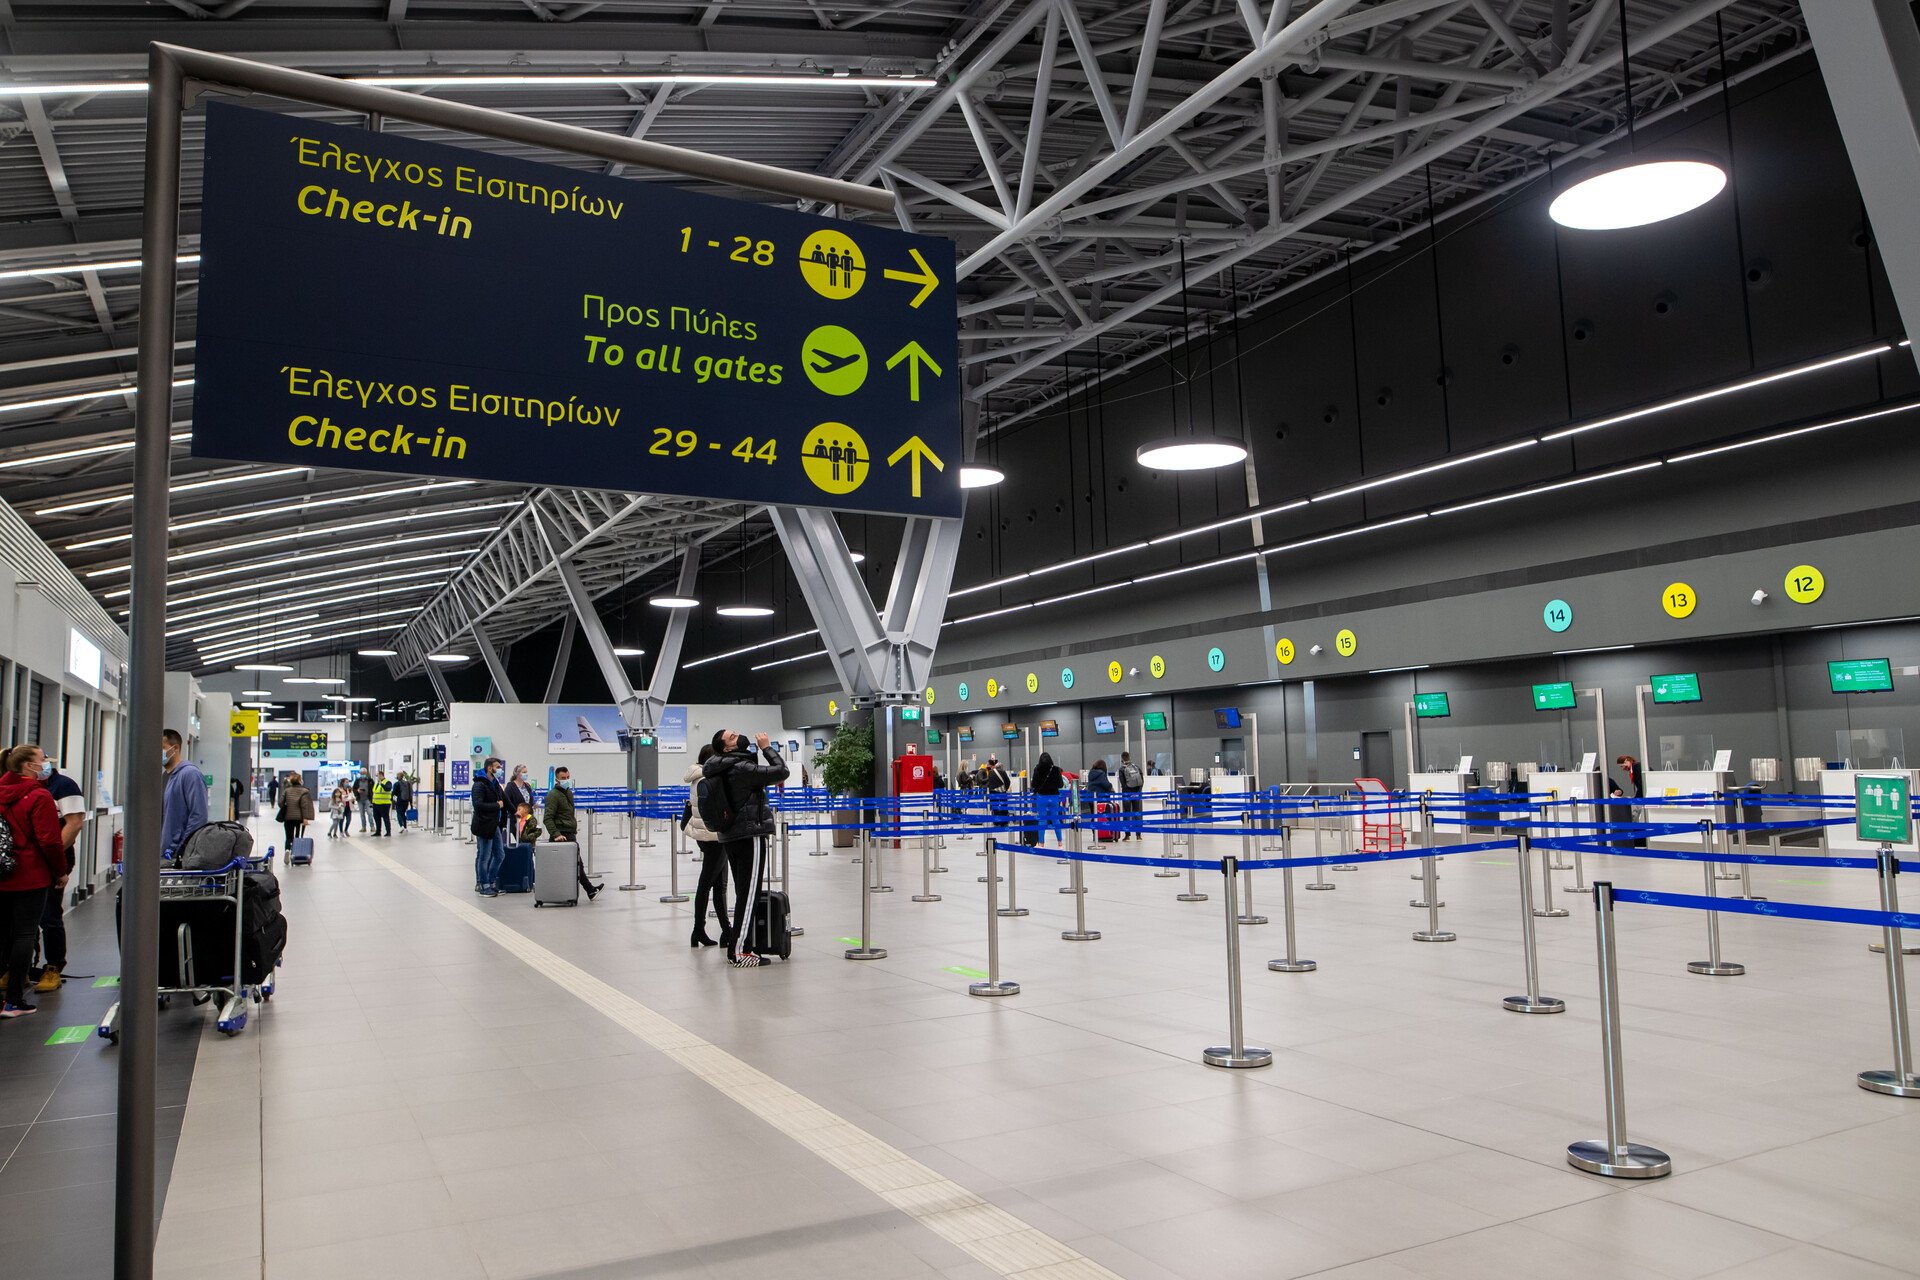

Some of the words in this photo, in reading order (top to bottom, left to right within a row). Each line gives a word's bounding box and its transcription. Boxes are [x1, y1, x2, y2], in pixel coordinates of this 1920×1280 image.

[290, 137, 443, 187] Έλεγχος
[456, 167, 624, 219] Εισιτηρίων
[298, 185, 471, 238] Check-in
[681, 227, 692, 252] 1
[730, 236, 774, 265] 28
[584, 295, 660, 328] Προς
[671, 307, 758, 340] Πύλες
[584, 336, 624, 365] To
[636, 345, 682, 374] all
[694, 356, 784, 384] gates
[281, 367, 436, 408] Έλεγχος
[450, 385, 621, 427] Εισιτηρίων
[289, 416, 467, 459] Check-in
[649, 428, 697, 457] 29
[732, 437, 777, 464] 44
[1793, 576, 1815, 593] 12
[1670, 593, 1688, 608] 13
[1549, 608, 1566, 623] 14
[1280, 646, 1290, 657] 16
[1340, 637, 1352, 649] 15
[1153, 662, 1162, 672] 18
[1211, 654, 1220, 665] 17
[1063, 674, 1072, 683] 20
[1111, 667, 1119, 677] 19
